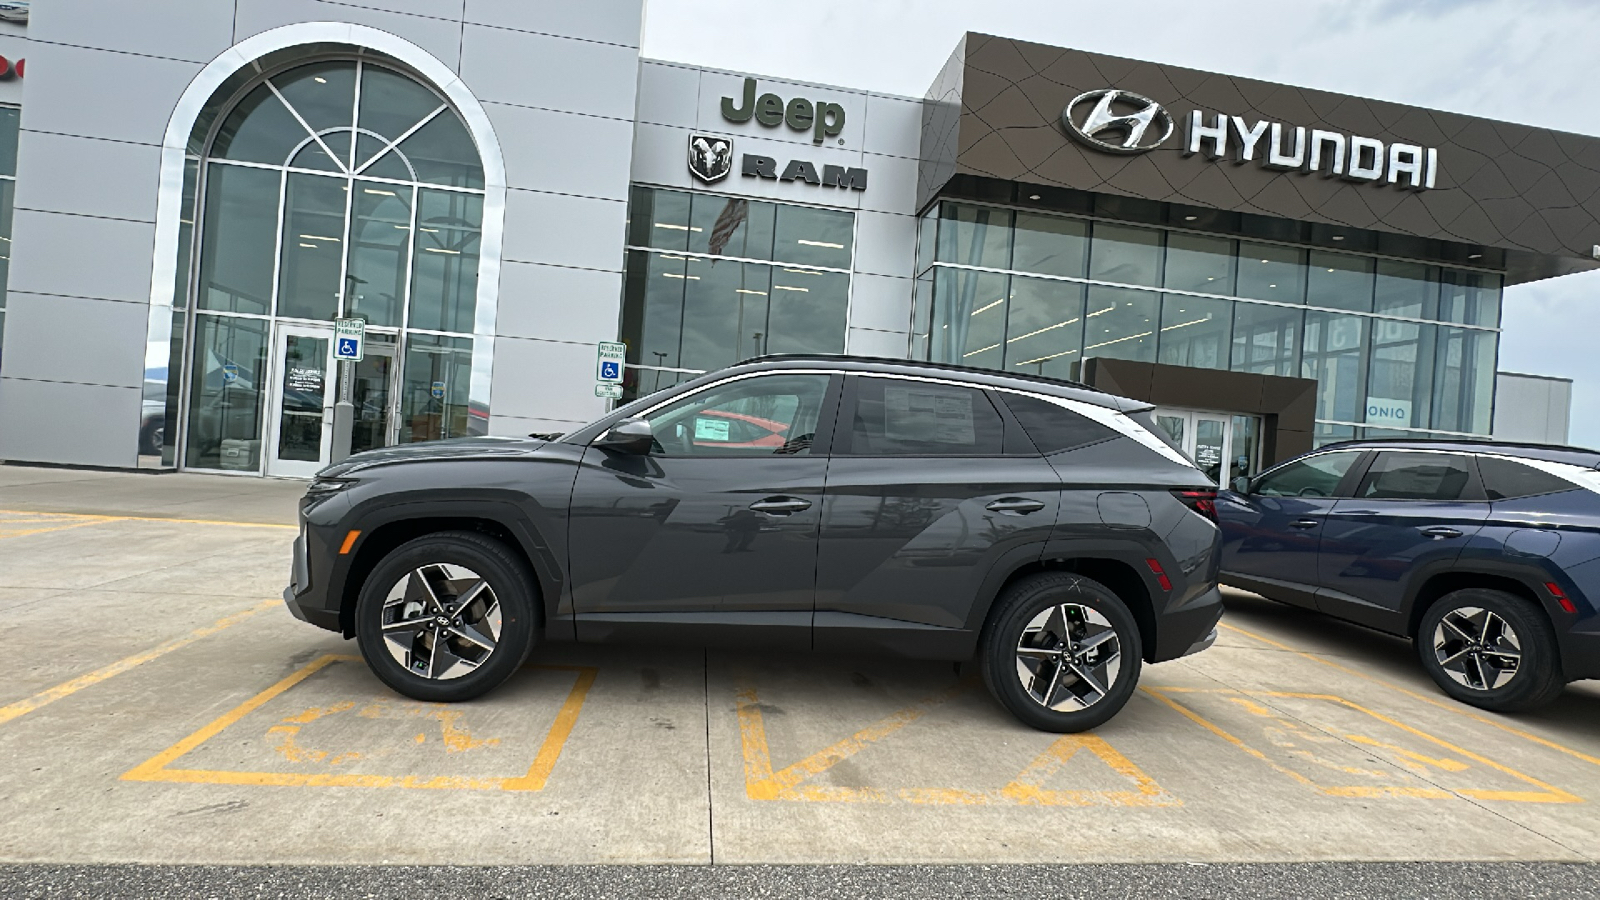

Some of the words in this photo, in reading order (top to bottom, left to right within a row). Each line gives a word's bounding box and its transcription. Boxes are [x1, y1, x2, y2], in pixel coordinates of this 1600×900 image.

[720, 76, 846, 143] Jeep
[741, 153, 868, 191] RAM
[1184, 109, 1438, 190] HYUNDAI
[1368, 405, 1405, 419] ONIQ
